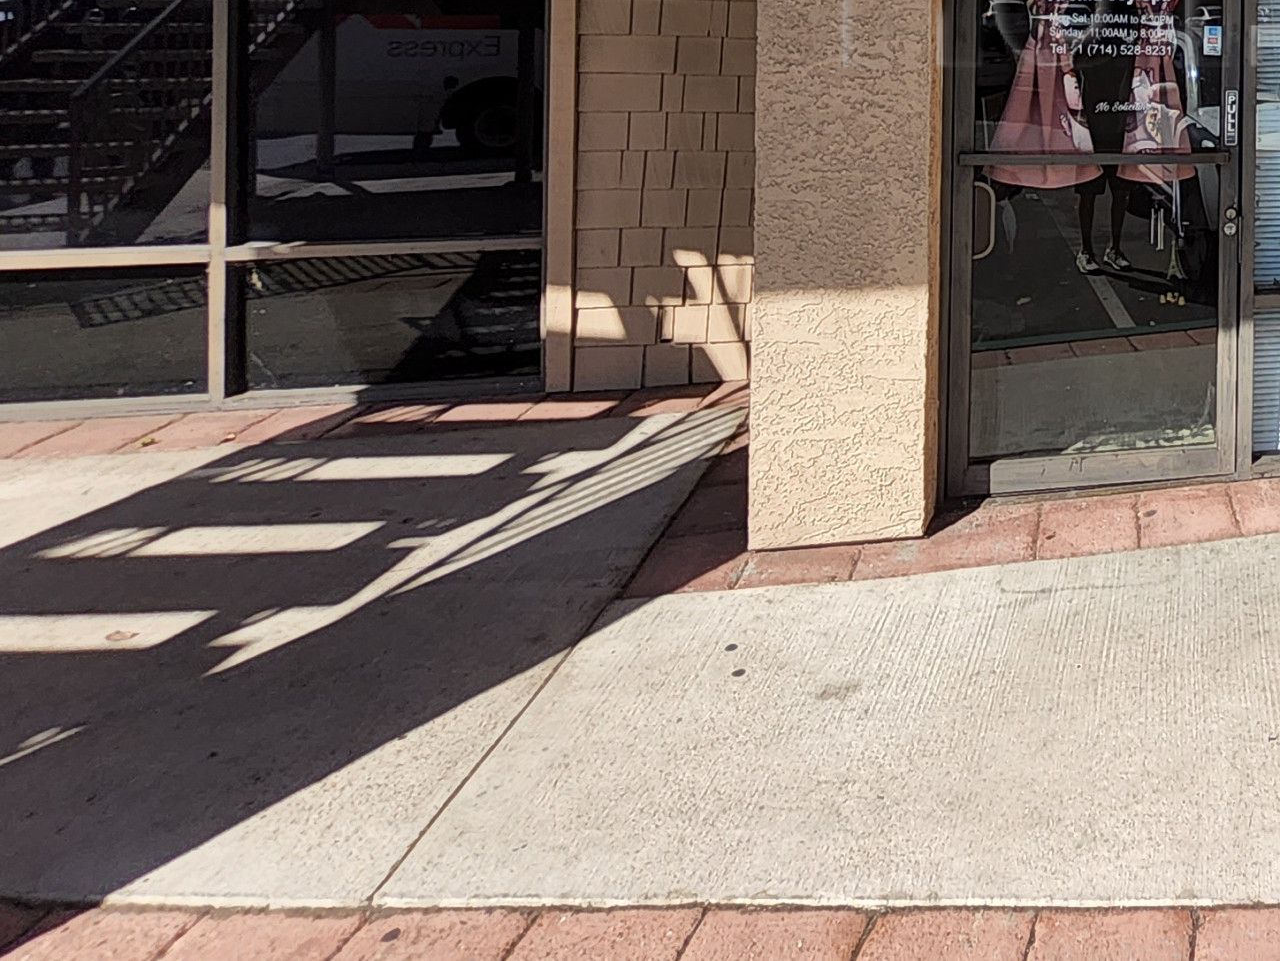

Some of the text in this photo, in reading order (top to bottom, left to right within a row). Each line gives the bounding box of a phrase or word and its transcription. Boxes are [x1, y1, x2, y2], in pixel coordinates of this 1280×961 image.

[1130, 15, 1139, 24] to
[1129, 28, 1138, 38] to
[1087, 44, 1117, 57] (714)
[1120, 44, 1172, 56] 528-8231
[1094, 101, 1110, 113] No
[1227, 95, 1237, 132] PULL
